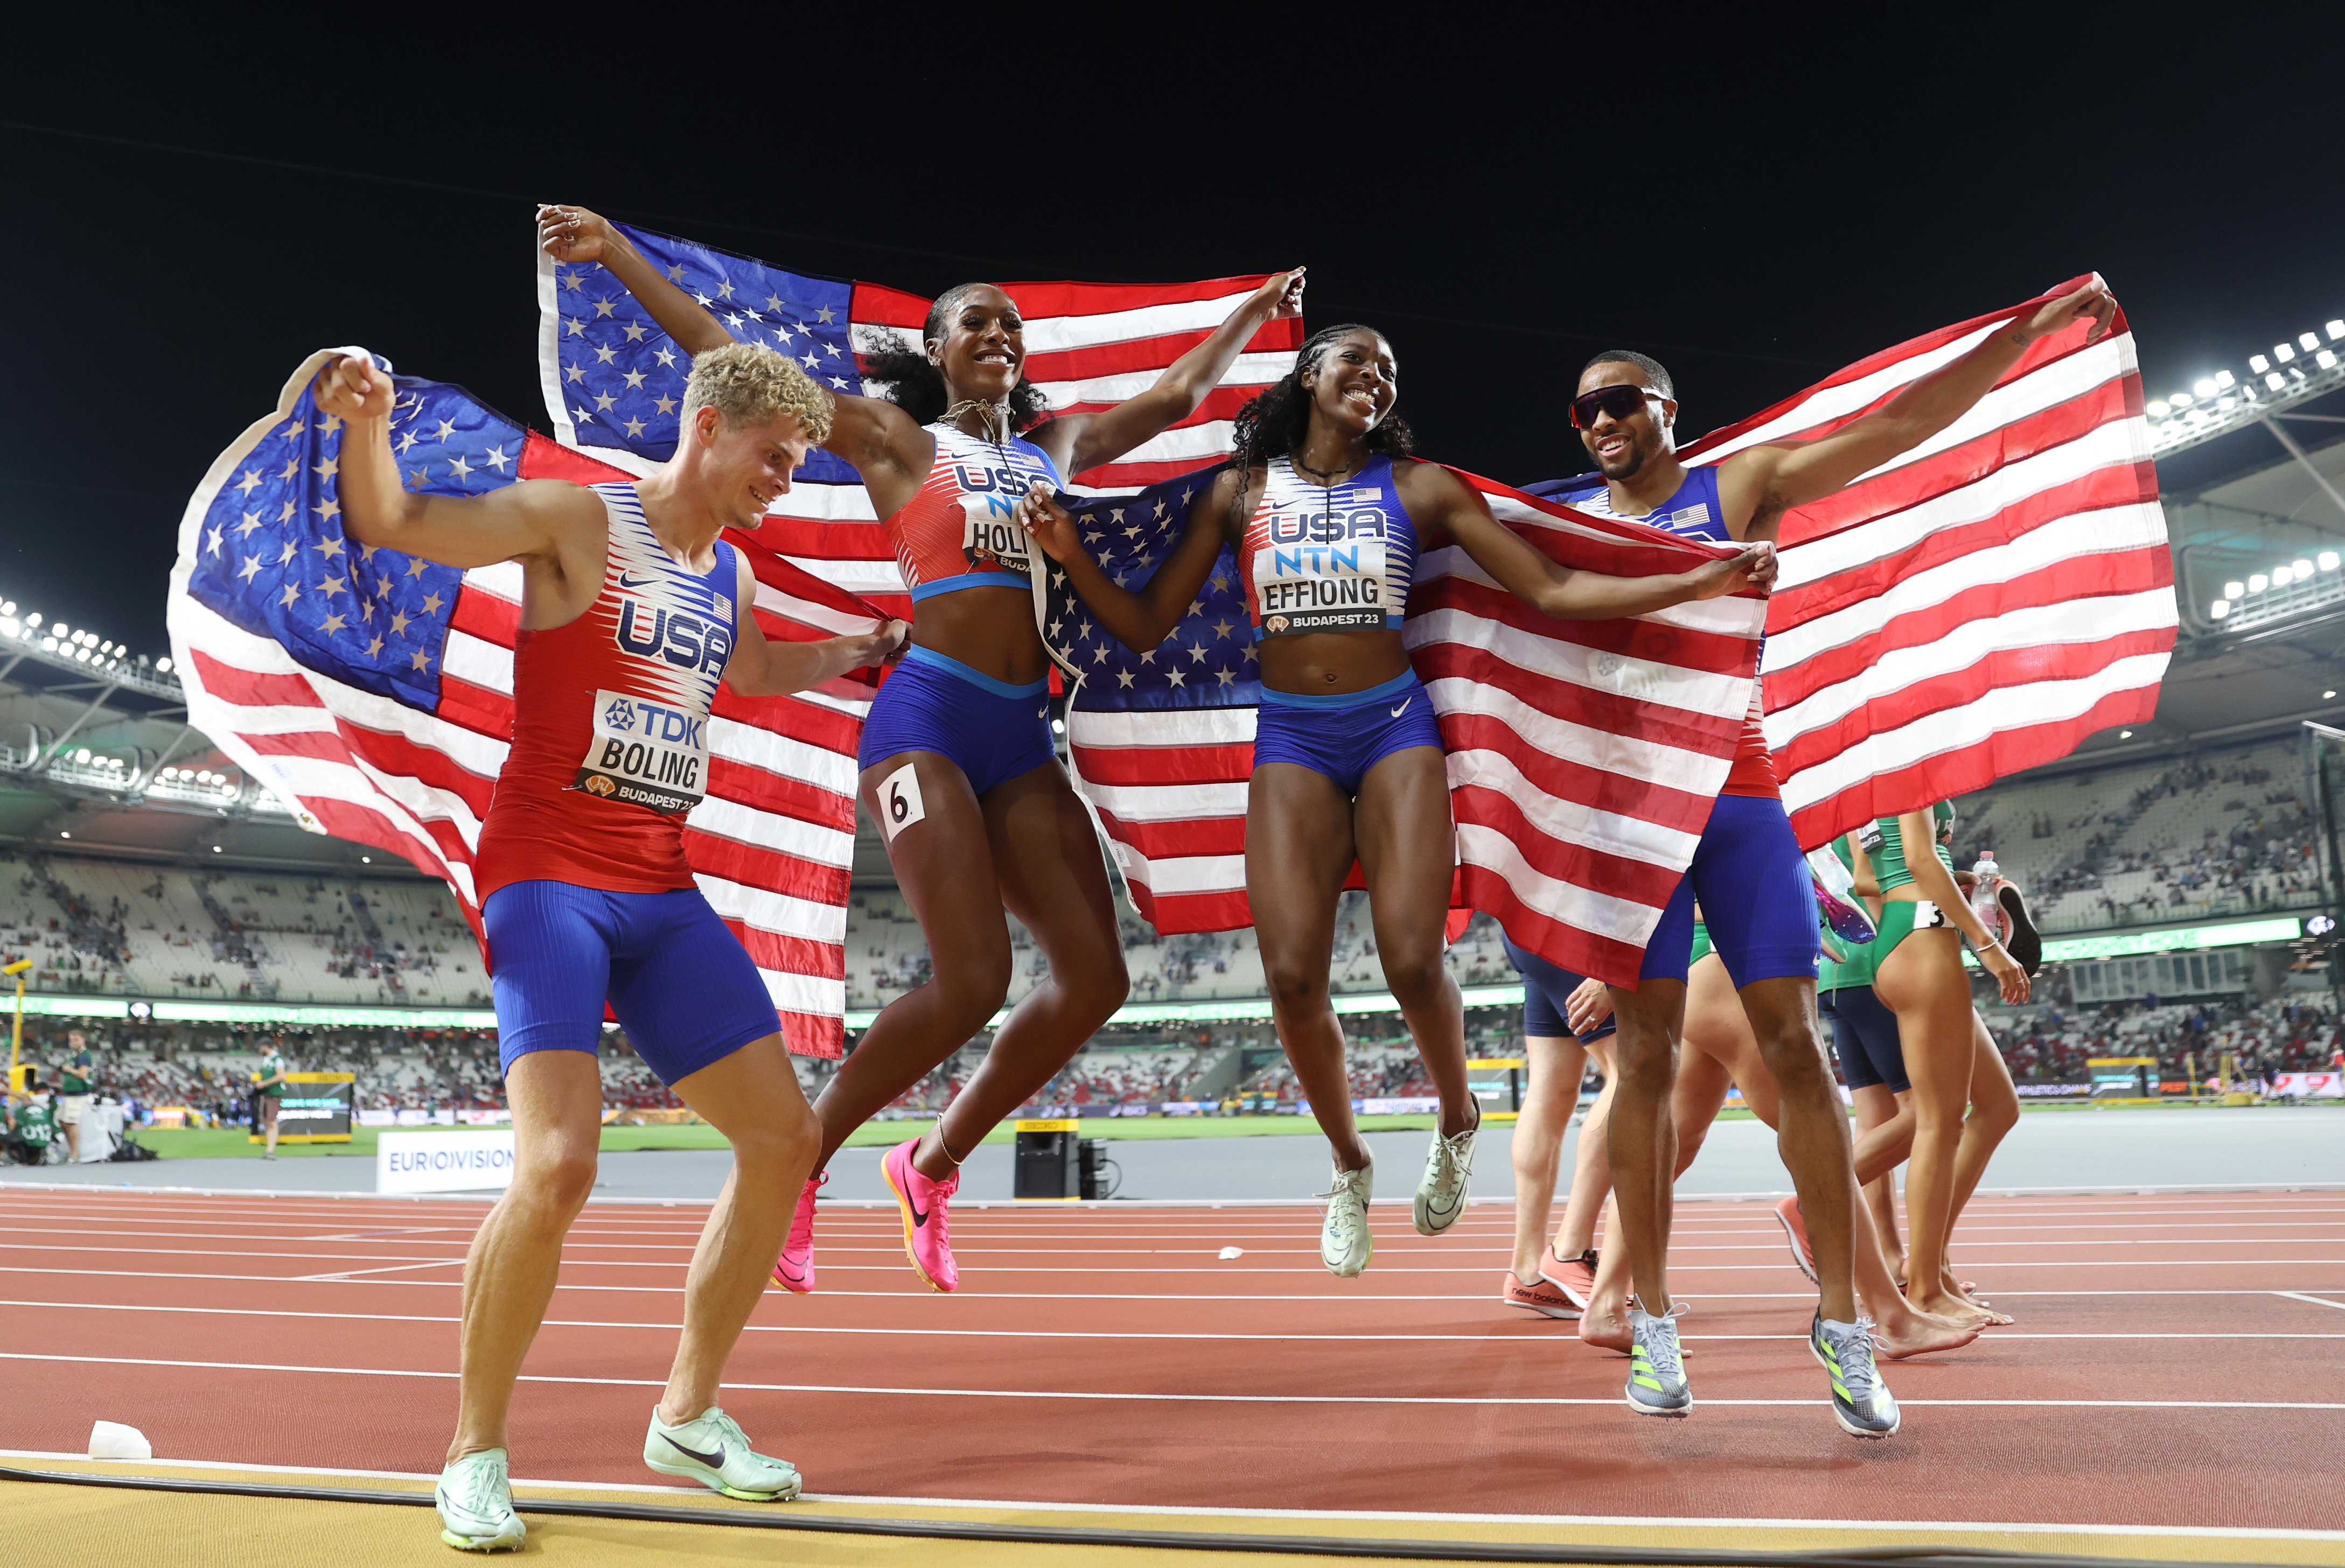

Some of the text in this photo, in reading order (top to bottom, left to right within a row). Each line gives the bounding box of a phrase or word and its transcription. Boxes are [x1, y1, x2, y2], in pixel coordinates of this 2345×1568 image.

[1270, 509, 1386, 545] USA
[1275, 545, 1358, 577] NTN
[1264, 577, 1378, 611] EFFIONG
[1293, 614, 1379, 627] BUDAPEST 23
[617, 599, 731, 681] USA
[637, 702, 702, 750] TDK
[599, 737, 699, 789] BOLING
[618, 786, 683, 810] BUDAPEST
[1512, 1288, 1532, 1298] new
